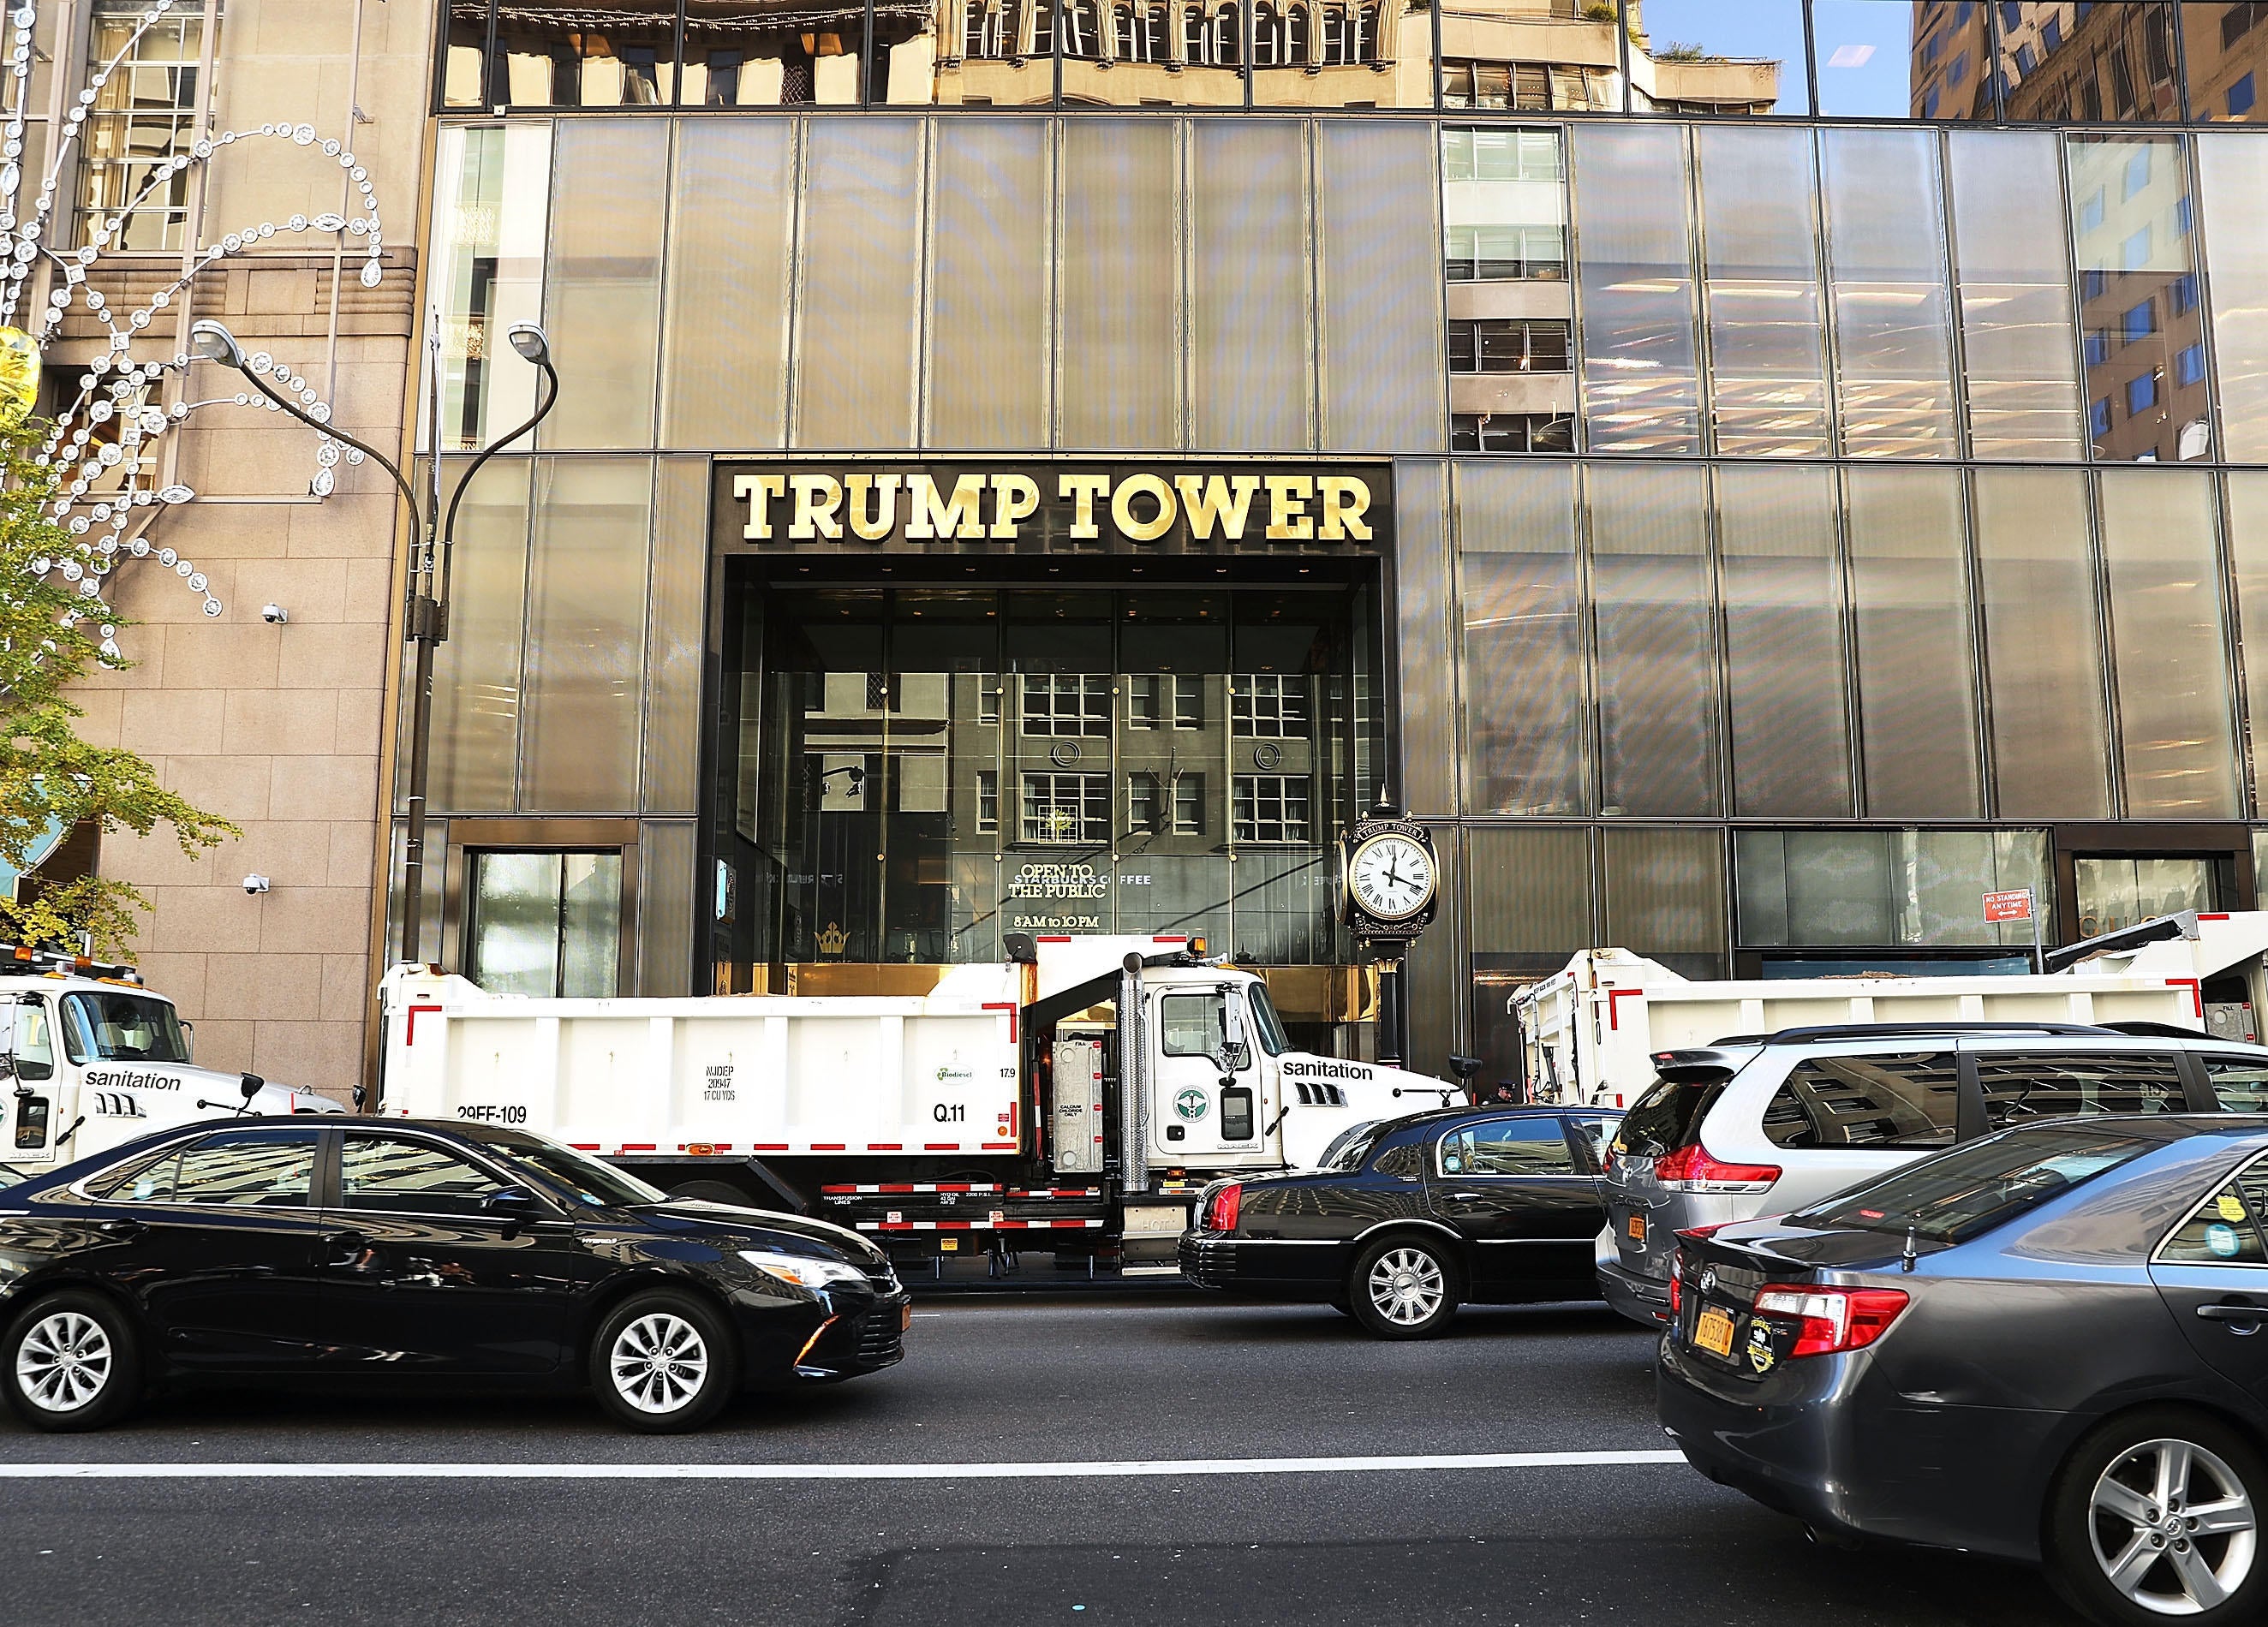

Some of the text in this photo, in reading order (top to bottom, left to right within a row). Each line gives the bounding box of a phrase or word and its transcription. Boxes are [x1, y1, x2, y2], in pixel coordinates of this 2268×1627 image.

[733, 473, 1373, 542] TRUMP TOWER
[1362, 823, 1418, 837] TRUMP TOWER
[1020, 863, 1094, 879] OPEN TO
[1014, 875, 1096, 885] STARBUCKS
[1007, 884, 1106, 898] THE PUBLIC
[1996, 892, 2029, 902] STANDING
[1991, 901, 2022, 909] ANYTIME
[706, 1065, 734, 1076] NJDEP
[1000, 1068, 1016, 1078] 17.9
[1283, 1060, 1373, 1081] sanitation
[85, 1070, 182, 1091] sanitation
[707, 1078, 731, 1088] 20947
[704, 1089, 711, 1101] 17
[457, 1106, 527, 1123] 29FF-109
[934, 1103, 964, 1123] Q.11
[1143, 1219, 1169, 1231] HOT
